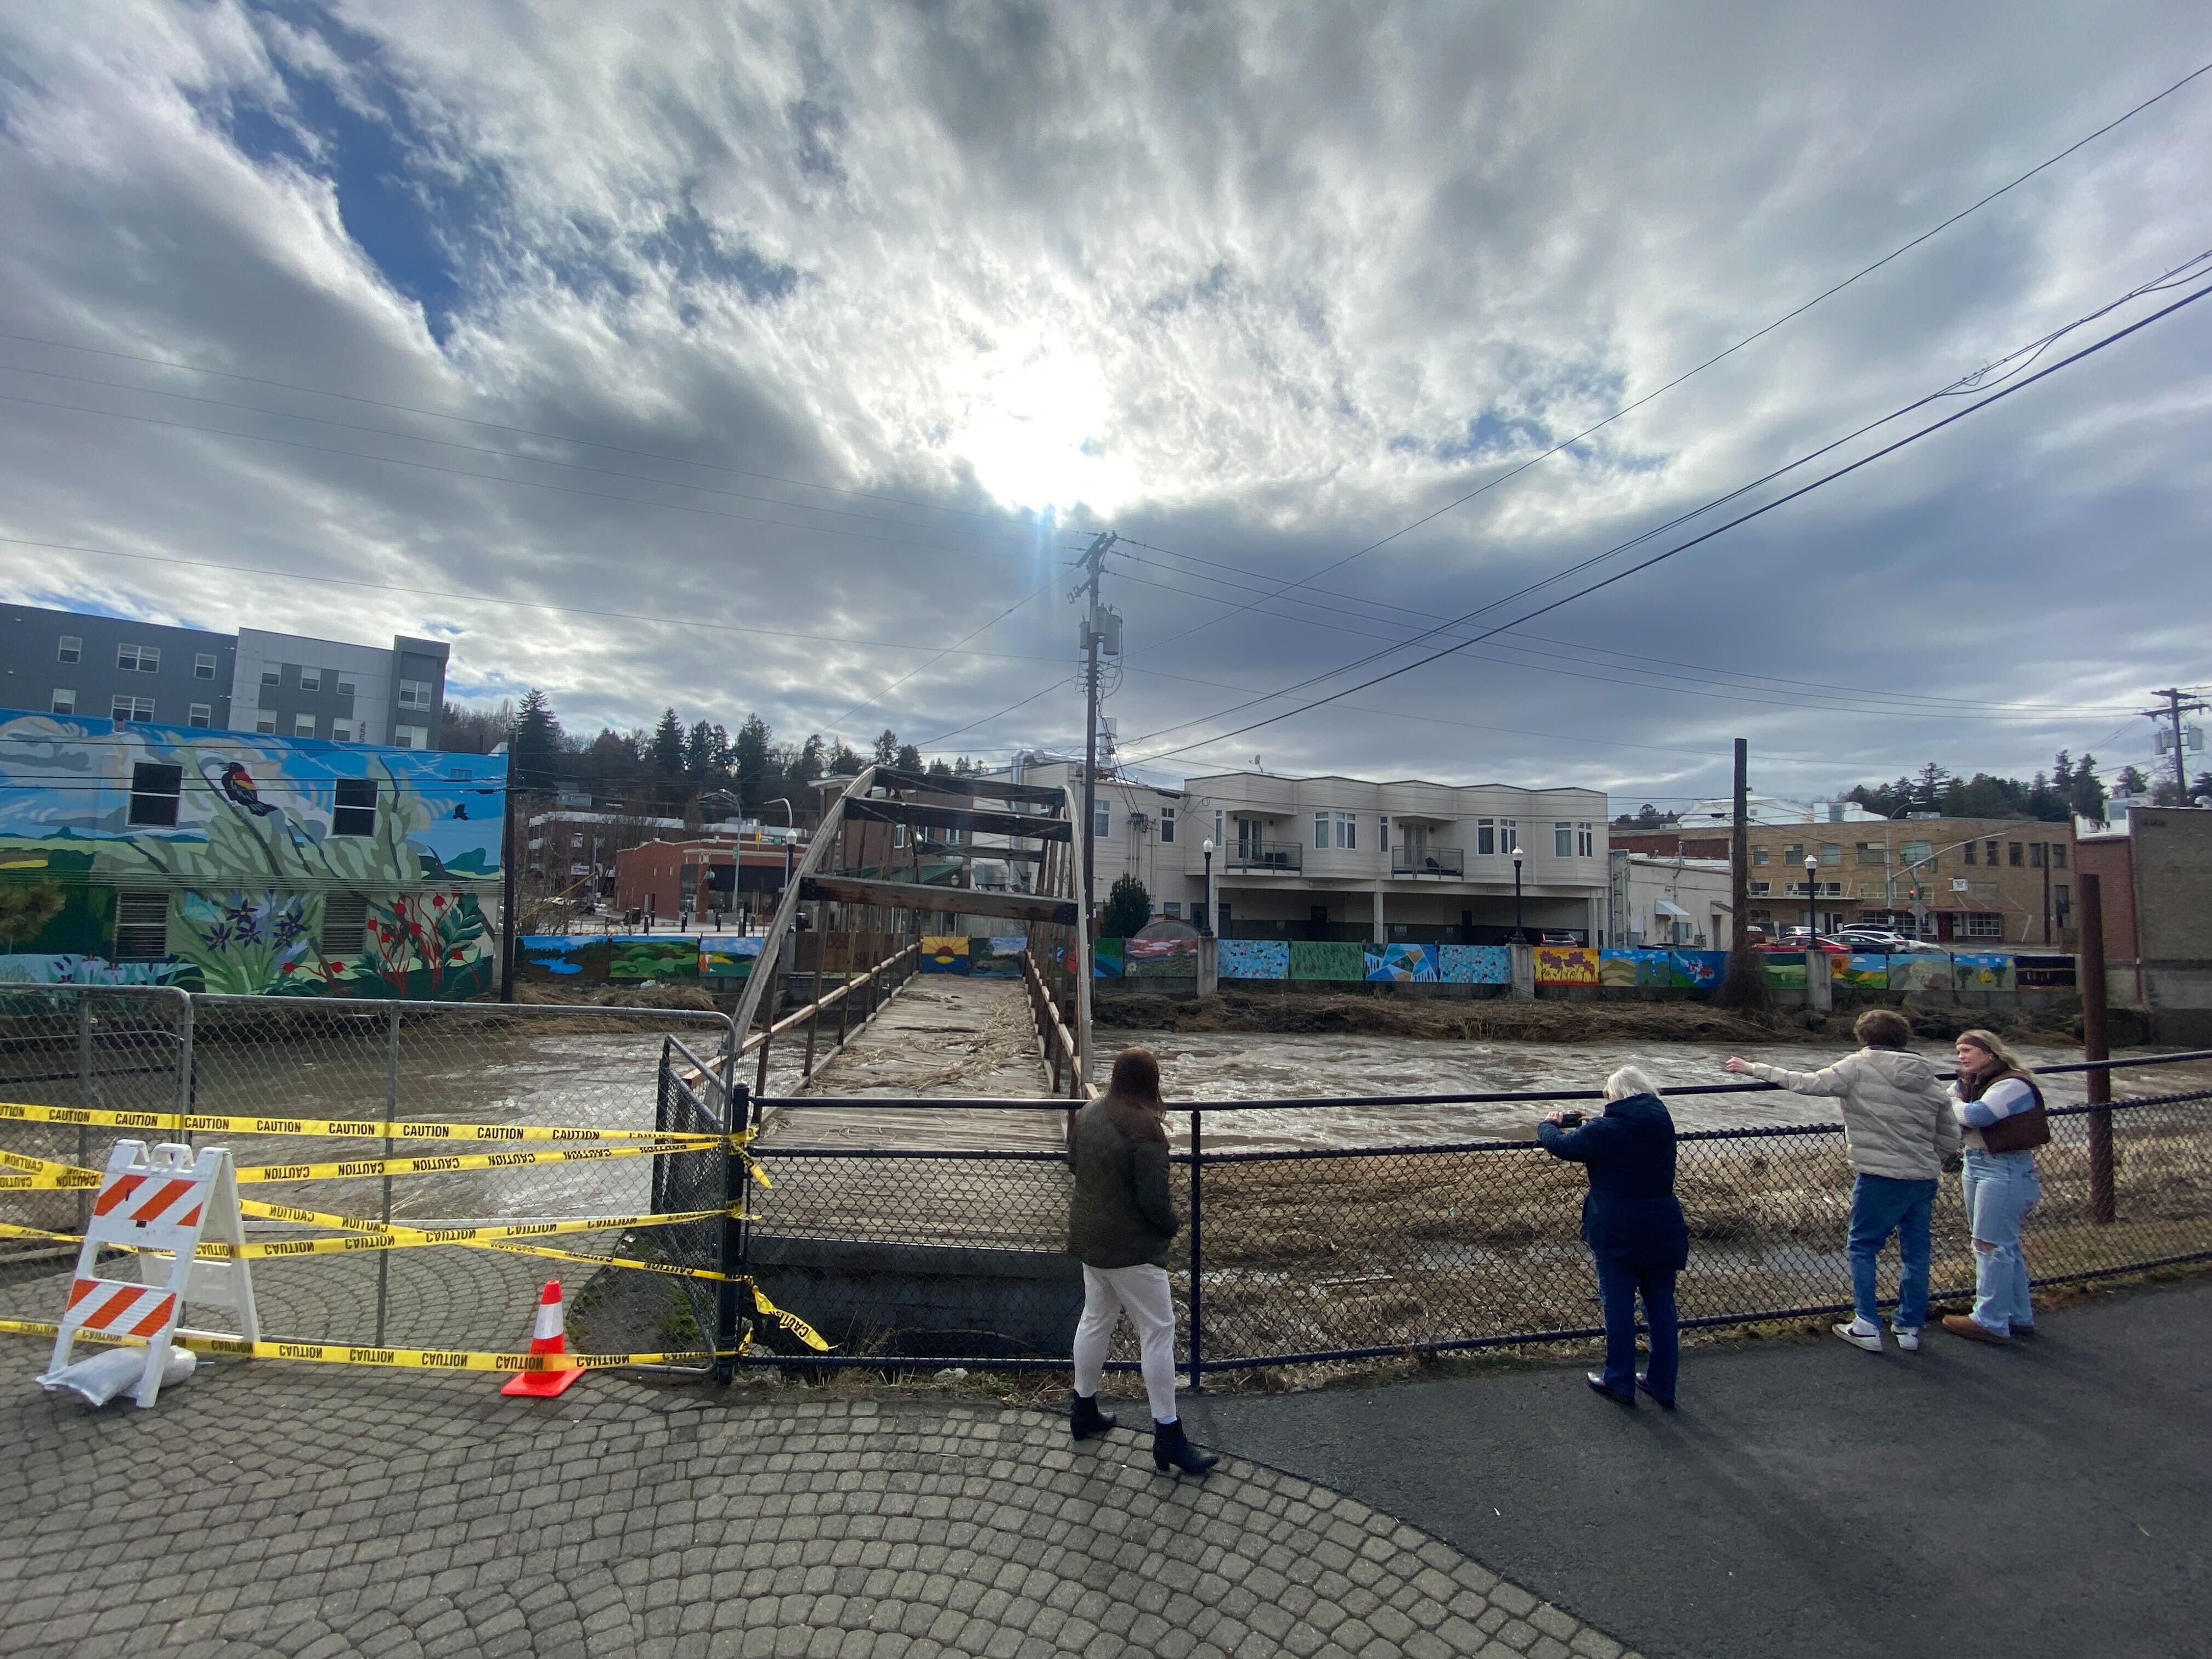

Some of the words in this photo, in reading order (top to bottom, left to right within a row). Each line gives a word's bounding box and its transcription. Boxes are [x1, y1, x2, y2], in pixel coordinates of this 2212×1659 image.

[49, 1109, 90, 1122] CAUTION
[115, 1113, 158, 1126] CAUTION
[185, 1117, 229, 1129] CAUTION
[257, 1120, 301, 1132] CAUTION
[329, 1123, 374, 1135] CAUTION
[403, 1125, 449, 1137] CAUTION
[478, 1127, 523, 1139] CAUTION
[552, 1129, 600, 1140] CAUTION
[264, 1166, 309, 1180] CAUTION
[338, 1163, 384, 1176] CAUTION
[413, 1158, 460, 1171] CAUTION
[488, 1153, 535, 1166] CAUTION
[563, 1149, 612, 1160] CAUTION
[56, 1175, 97, 1187] CAUTION
